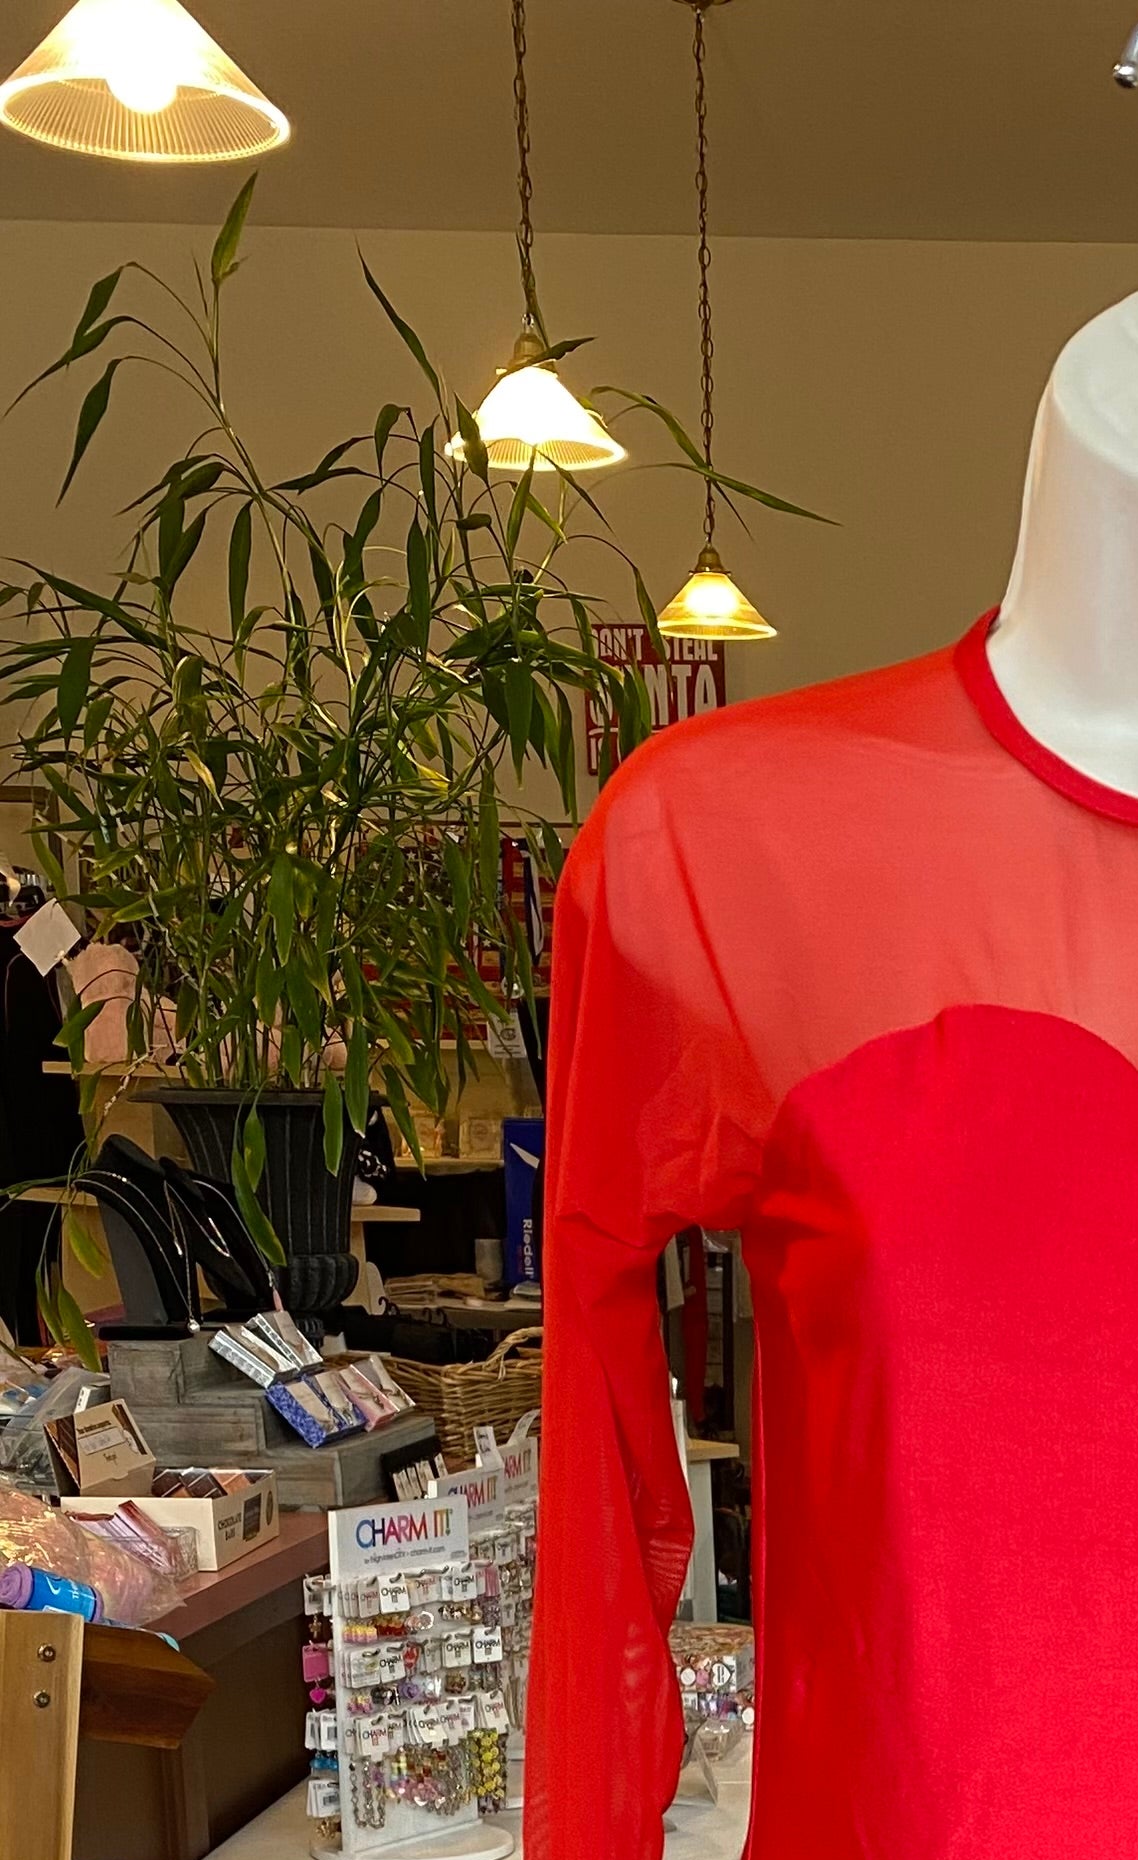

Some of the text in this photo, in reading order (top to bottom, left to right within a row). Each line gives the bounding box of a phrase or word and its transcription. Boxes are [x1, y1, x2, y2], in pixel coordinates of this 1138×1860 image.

[523, 1218, 534, 1275] Riedell
[355, 1508, 451, 1549] CHARM IT!
